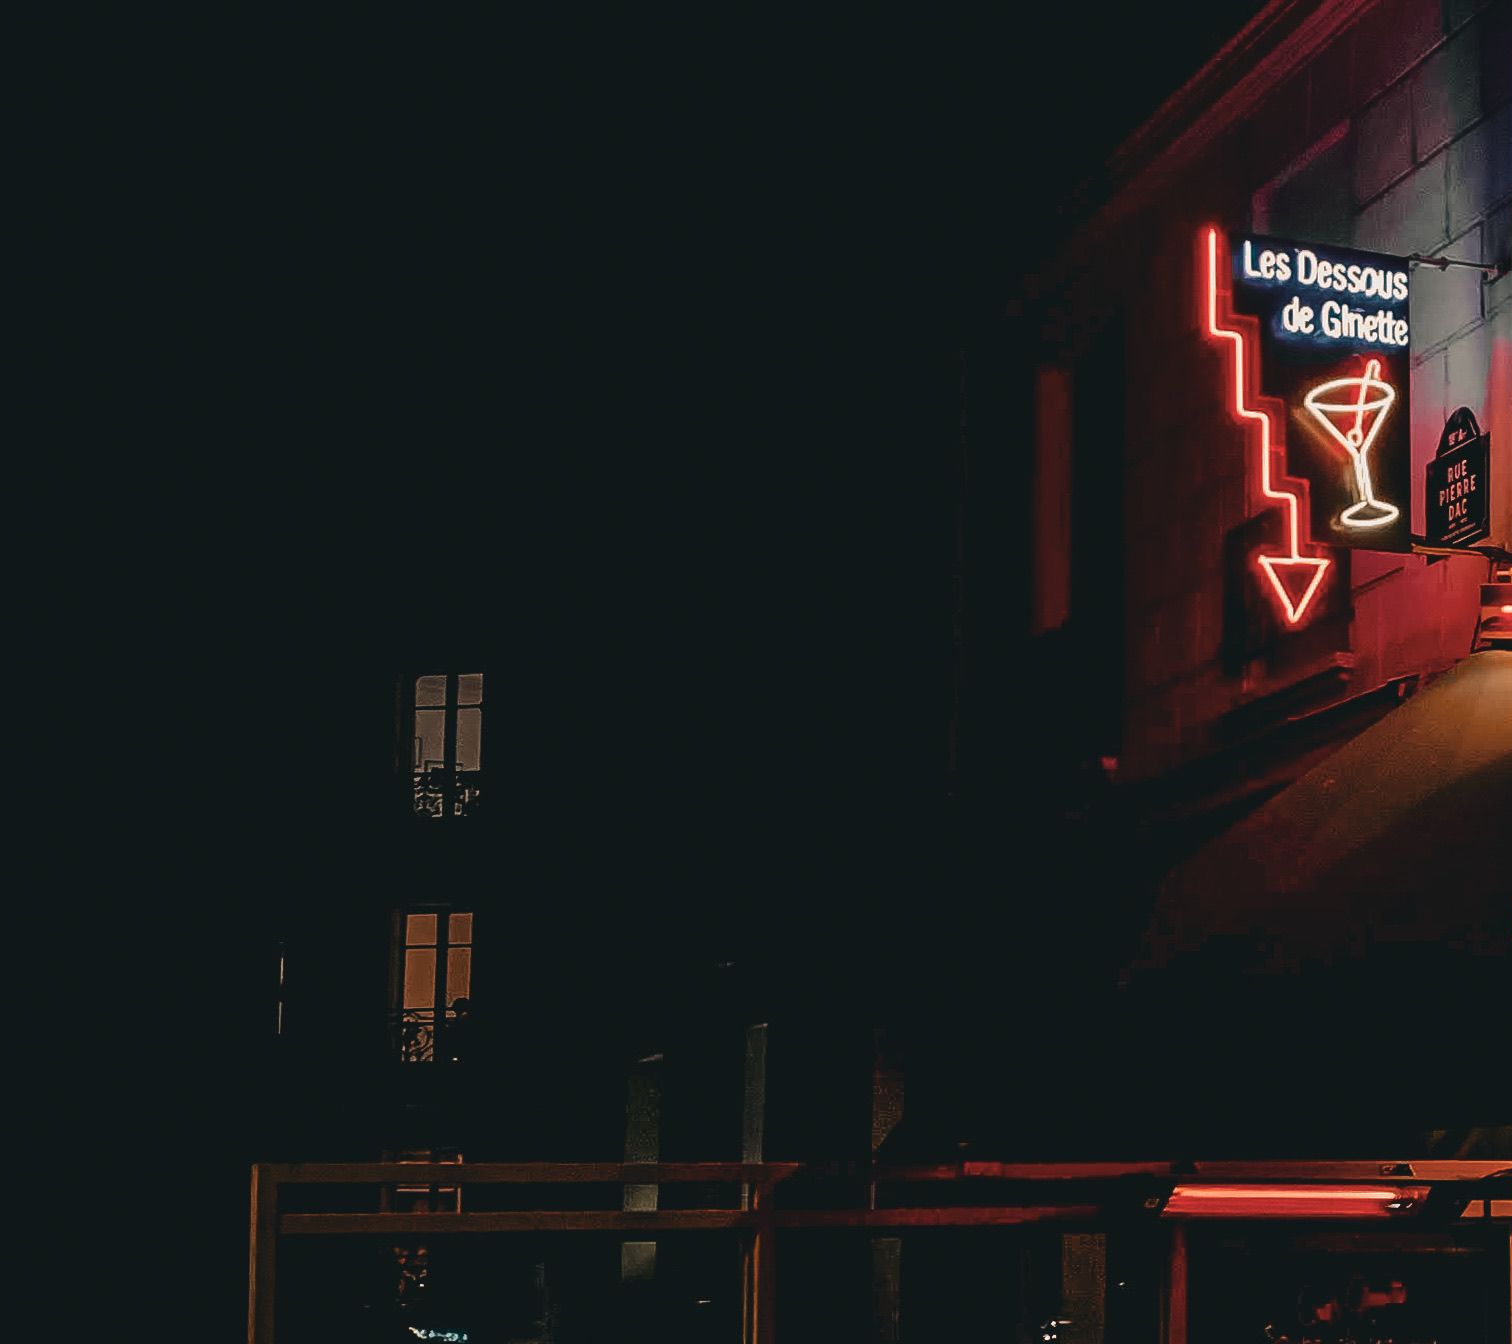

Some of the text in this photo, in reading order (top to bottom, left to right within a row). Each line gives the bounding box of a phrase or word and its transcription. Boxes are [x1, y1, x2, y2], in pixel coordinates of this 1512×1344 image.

[1243, 240, 1408, 301] Les Dessous
[1282, 296, 1408, 347] de Ginette
[1447, 459, 1468, 483] RUE
[1439, 474, 1476, 507] PIERRE
[1448, 498, 1468, 521] DAC
